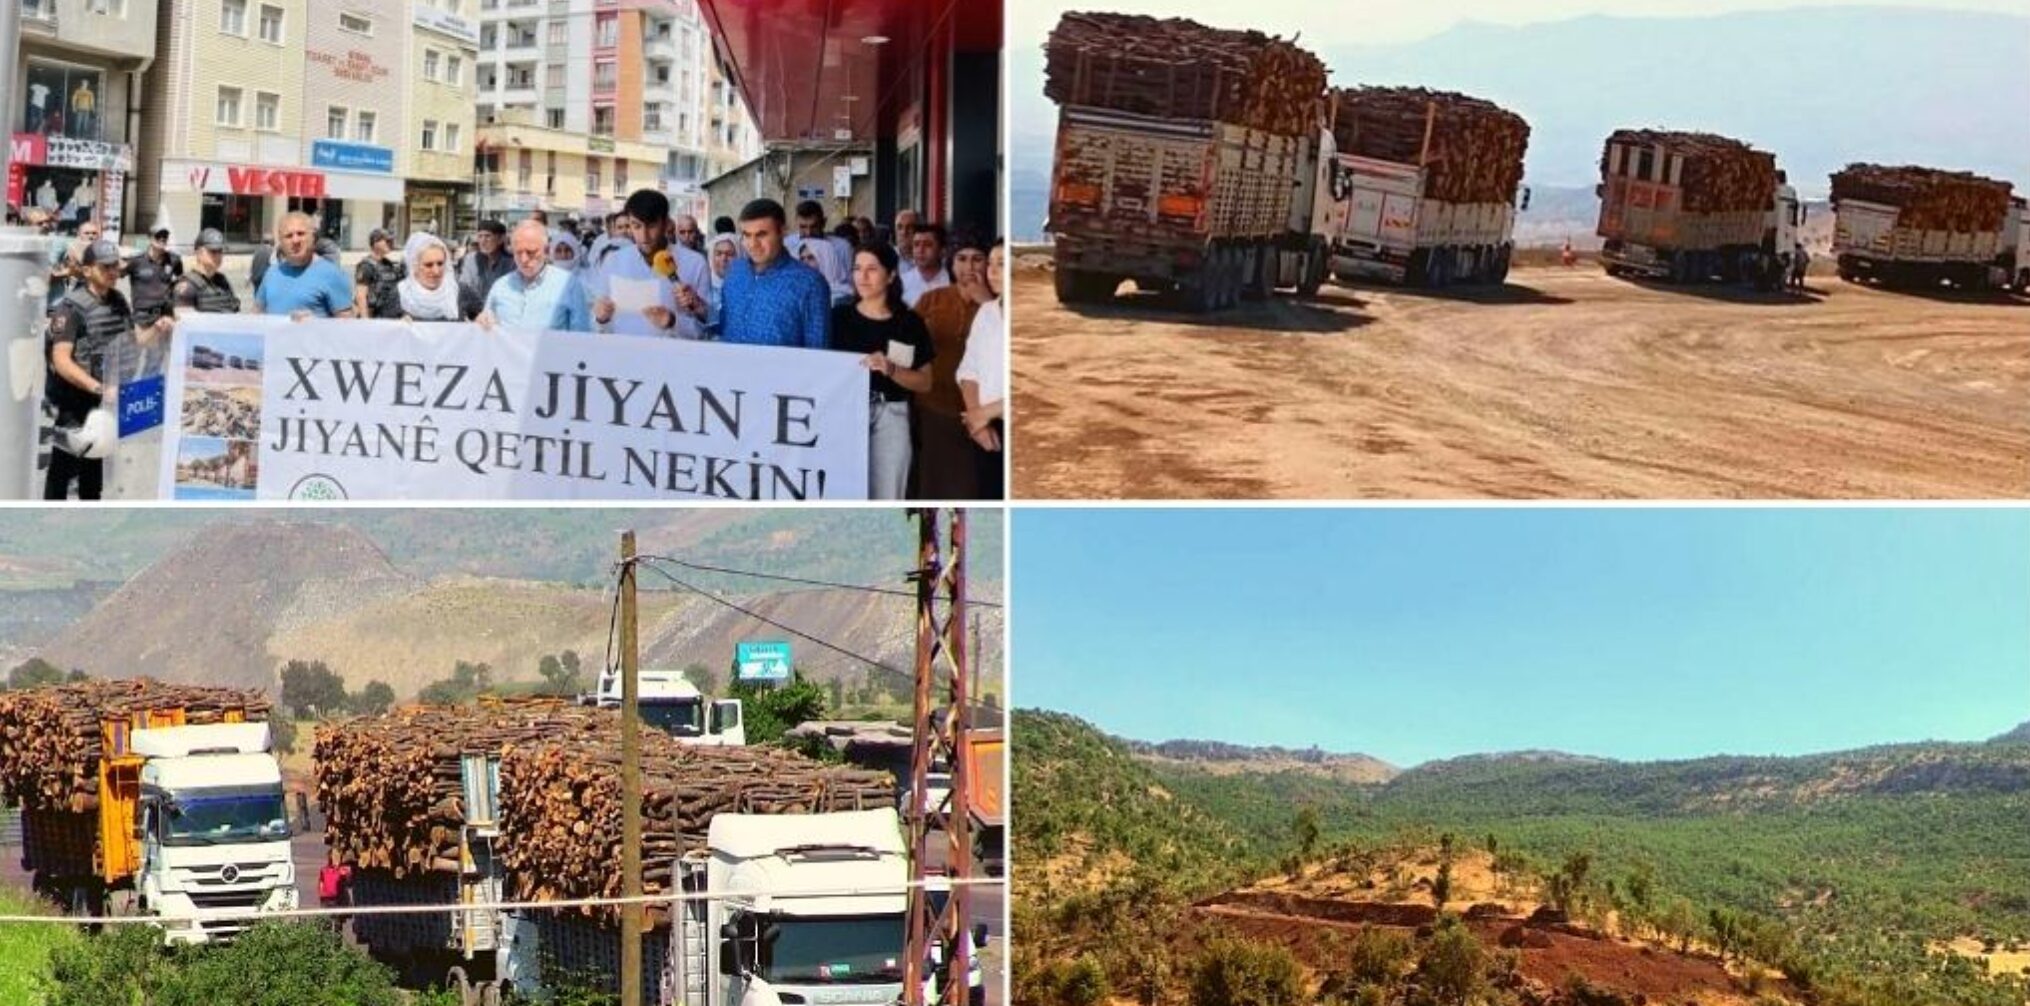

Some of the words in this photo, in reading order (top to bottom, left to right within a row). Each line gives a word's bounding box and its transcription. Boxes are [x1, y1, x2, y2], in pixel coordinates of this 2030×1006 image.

[227, 166, 326, 197] VESTEL
[283, 356, 515, 414] XWEZA
[535, 361, 747, 440] JİYAN
[771, 393, 820, 449] E
[270, 408, 440, 463] JİYANÊ
[455, 428, 607, 481] QETİL
[621, 447, 827, 500] NEKİN!
